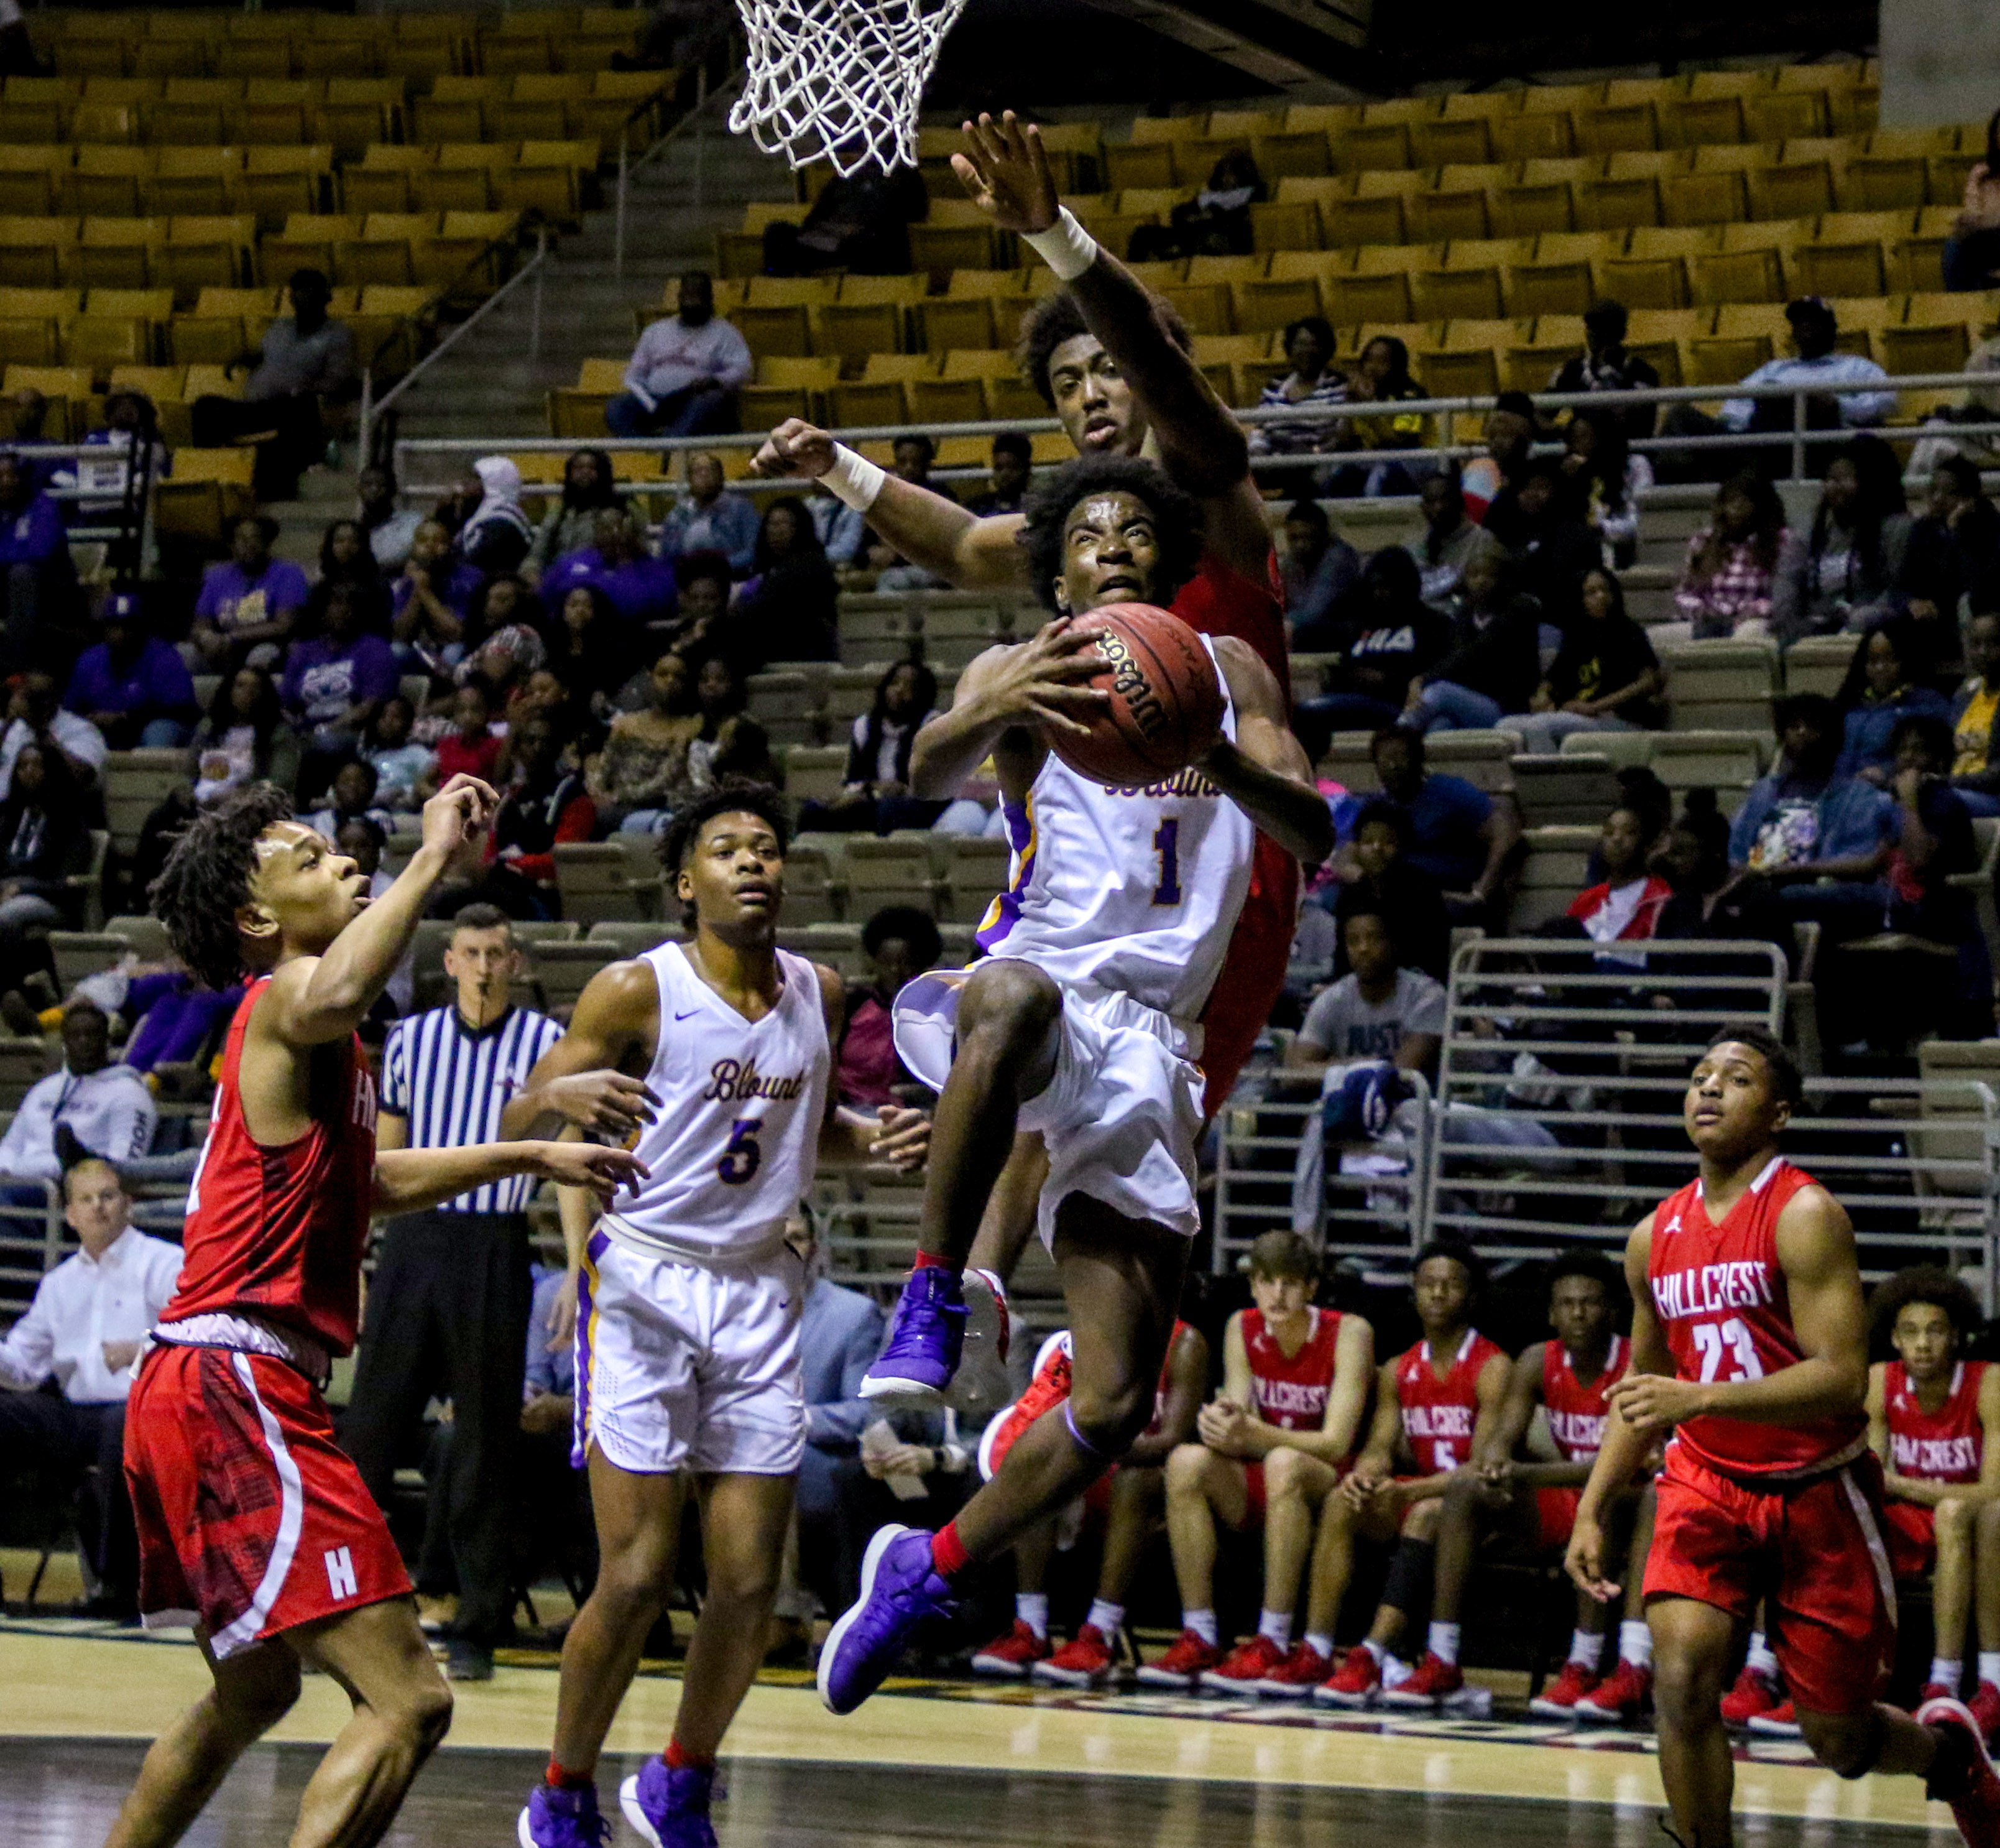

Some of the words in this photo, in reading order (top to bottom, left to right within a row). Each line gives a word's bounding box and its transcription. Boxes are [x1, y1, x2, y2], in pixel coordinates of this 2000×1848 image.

[1151, 816, 1181, 905] 1
[704, 1058, 804, 1101] Blount
[718, 1119, 763, 1184] 5
[1652, 1261, 1772, 1319] HILLCREST
[1435, 1440, 1457, 1471] 5
[324, 1546, 358, 1601] H
